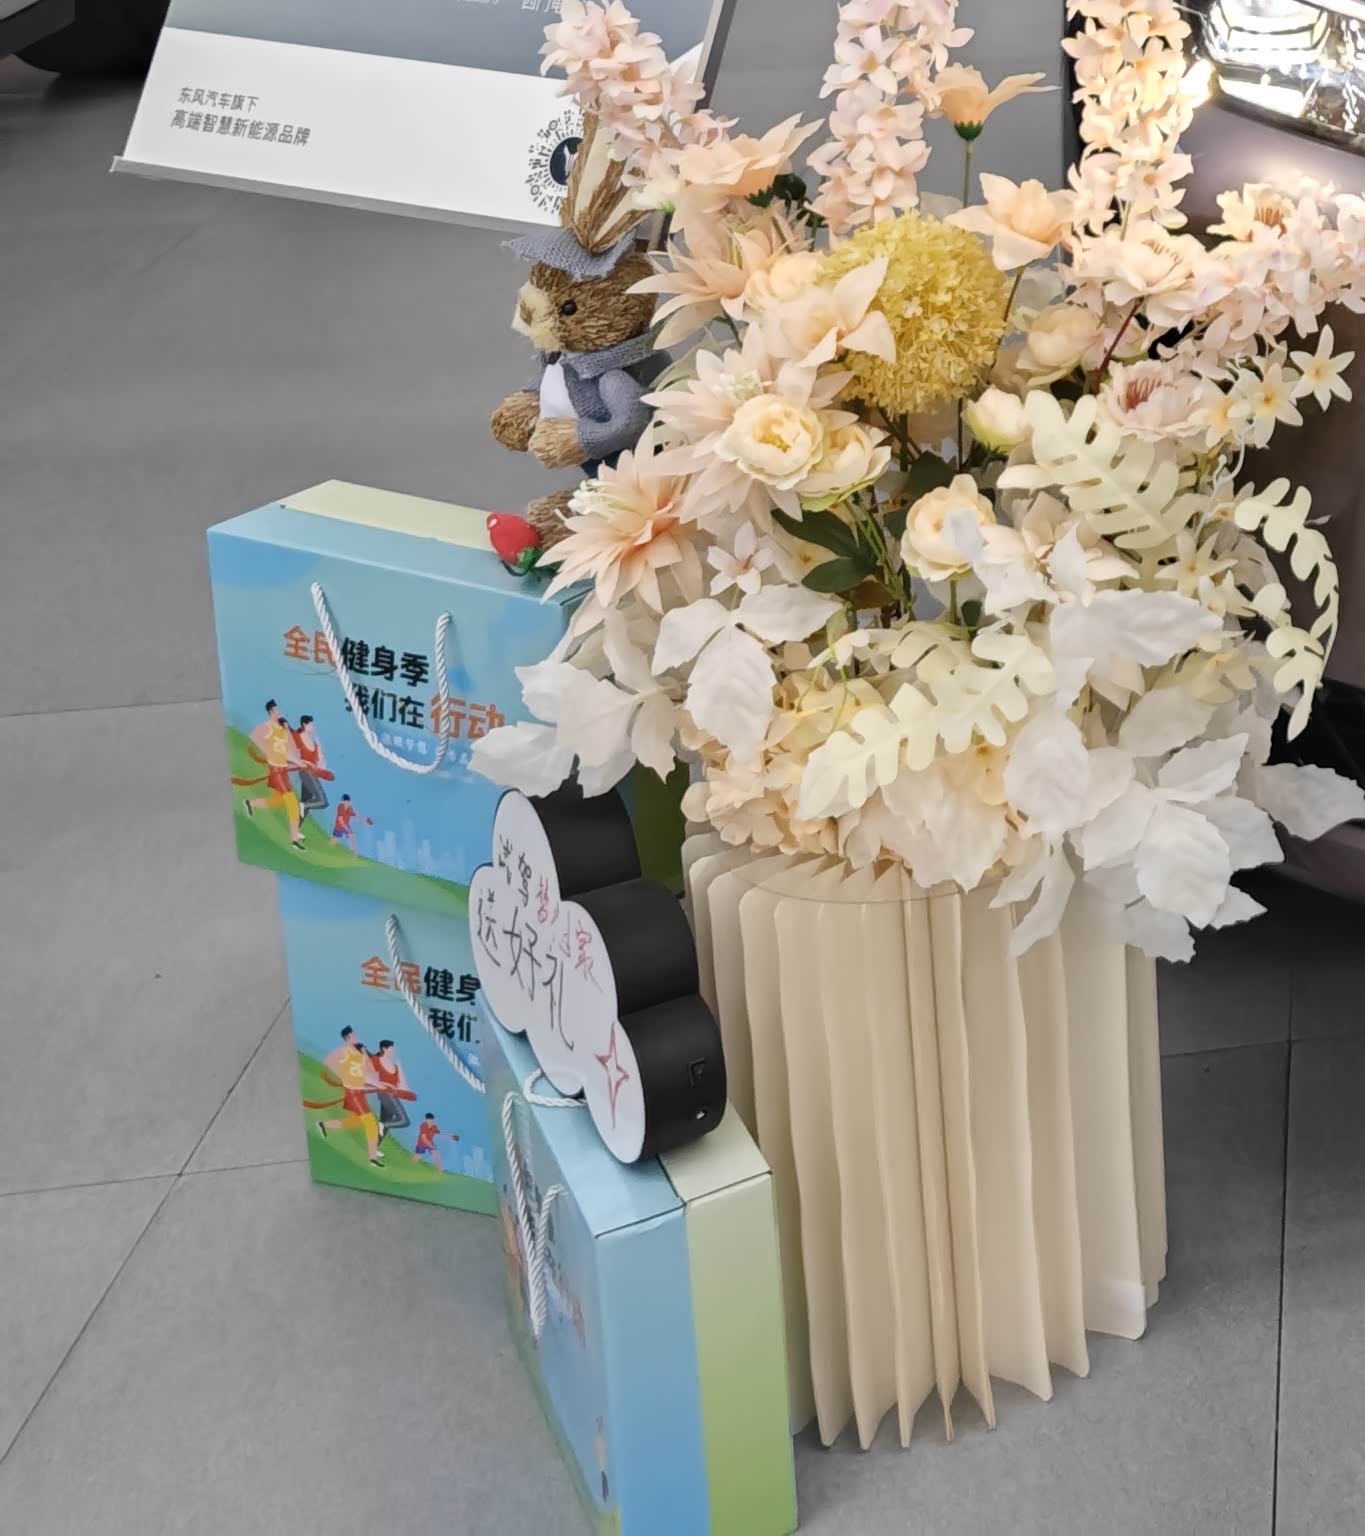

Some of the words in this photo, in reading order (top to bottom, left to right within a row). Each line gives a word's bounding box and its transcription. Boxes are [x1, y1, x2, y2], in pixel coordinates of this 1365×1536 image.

[177, 86, 260, 112] 东风汽车旗下
[170, 109, 312, 146] 高端智慧新能源品牌
[283, 624, 430, 688] 全民健身季
